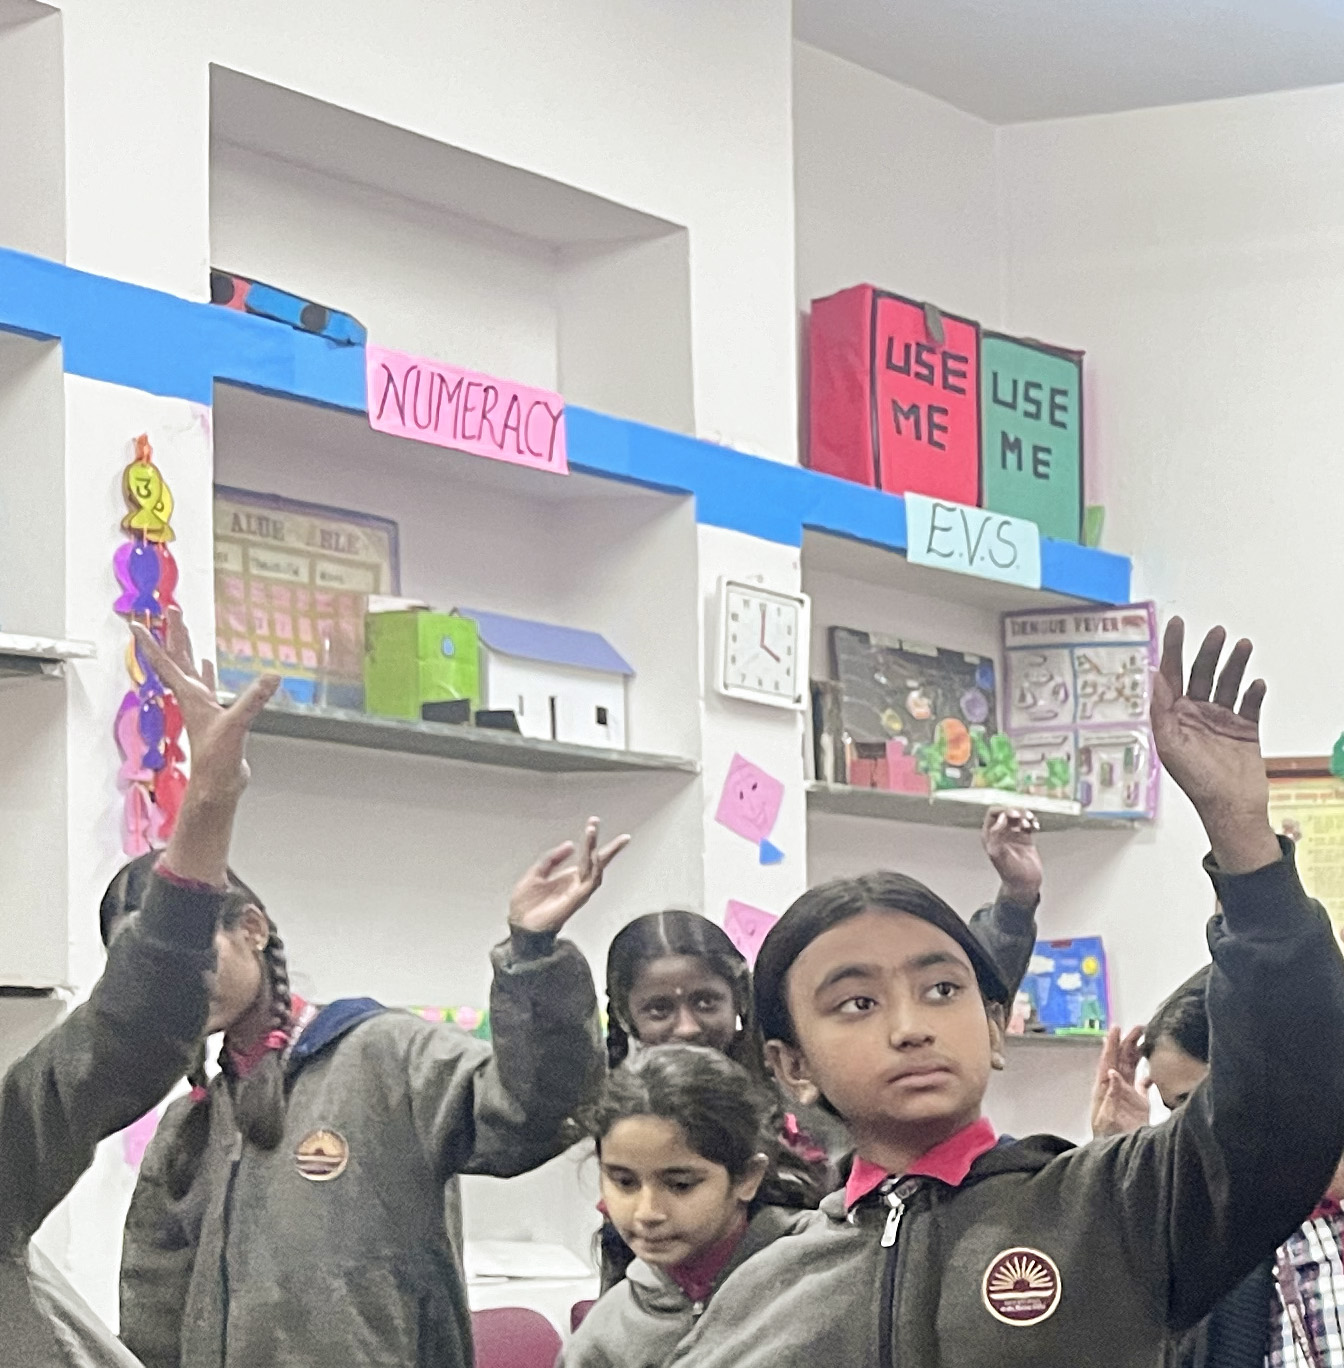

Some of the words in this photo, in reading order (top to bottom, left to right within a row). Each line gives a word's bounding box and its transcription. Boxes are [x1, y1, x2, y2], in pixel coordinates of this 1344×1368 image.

[885, 336, 969, 396] USE
[376, 363, 565, 462] NUMERACY
[891, 398, 949, 451] ME
[991, 371, 1070, 430] USE
[1001, 430, 1053, 480] ME
[231, 512, 286, 542] ALUE
